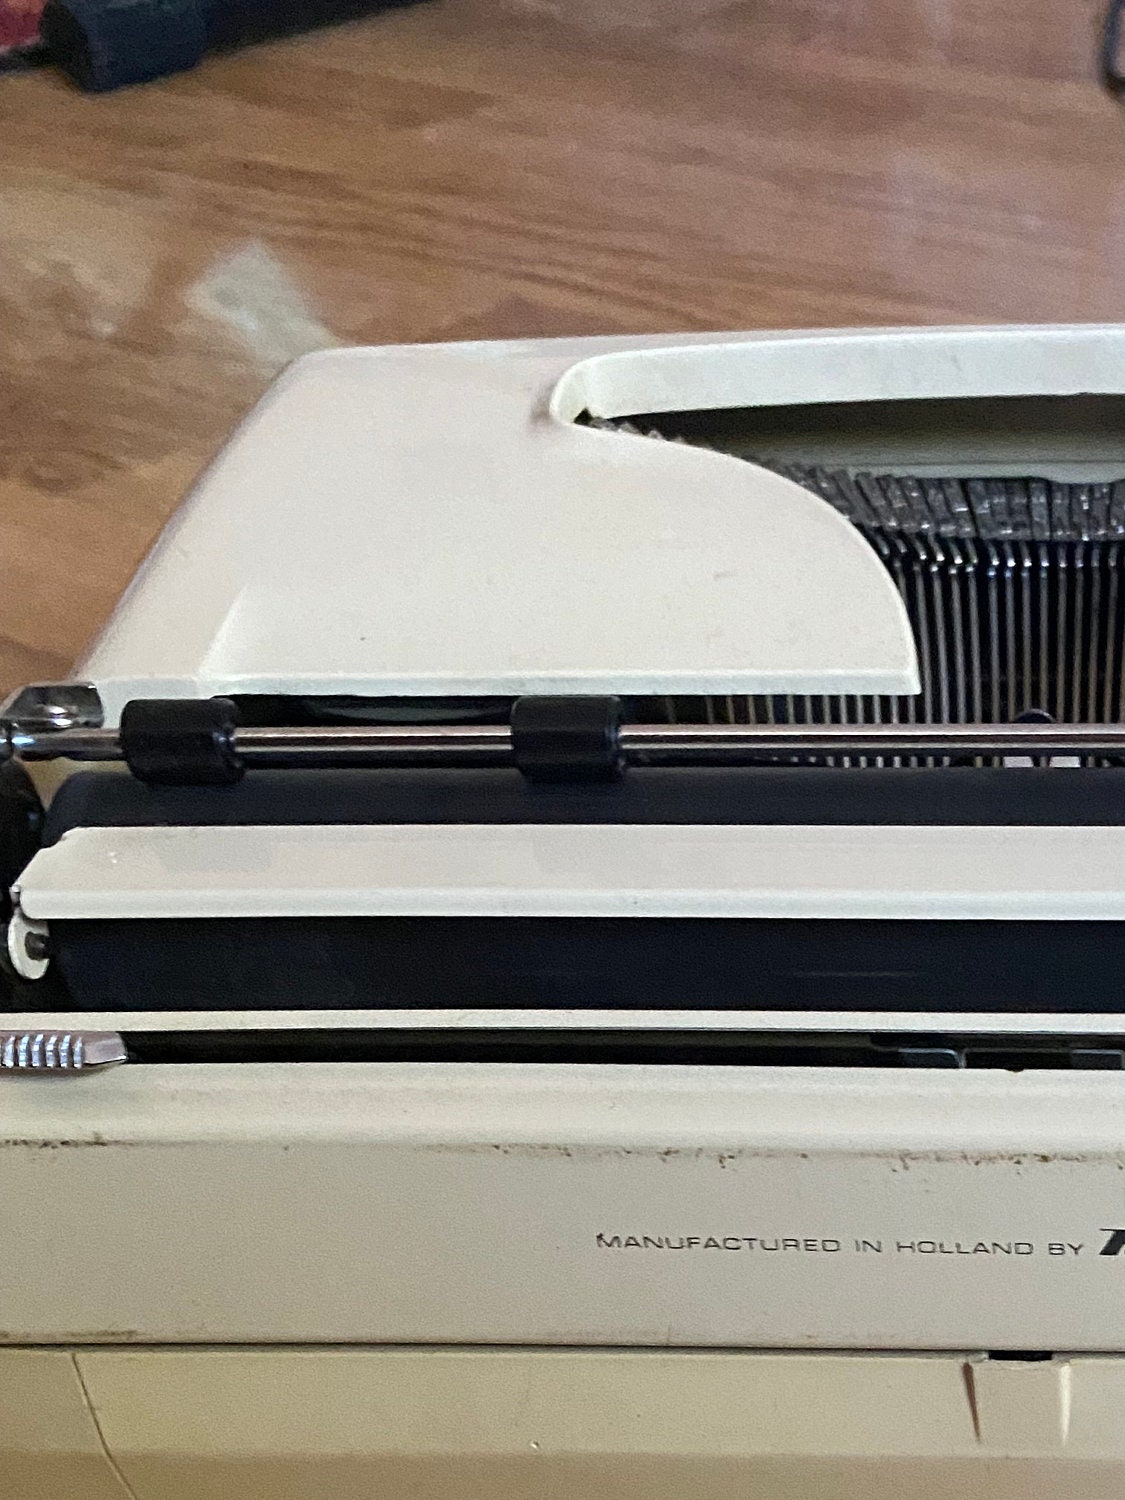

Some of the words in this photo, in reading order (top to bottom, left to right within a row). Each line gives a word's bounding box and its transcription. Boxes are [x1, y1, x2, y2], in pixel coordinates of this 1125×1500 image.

[596, 1232, 841, 1253] MANUFACTURED
[854, 1238, 882, 1254] IN
[896, 1239, 1034, 1255] HOLLAND
[1047, 1242, 1085, 1256] BY
